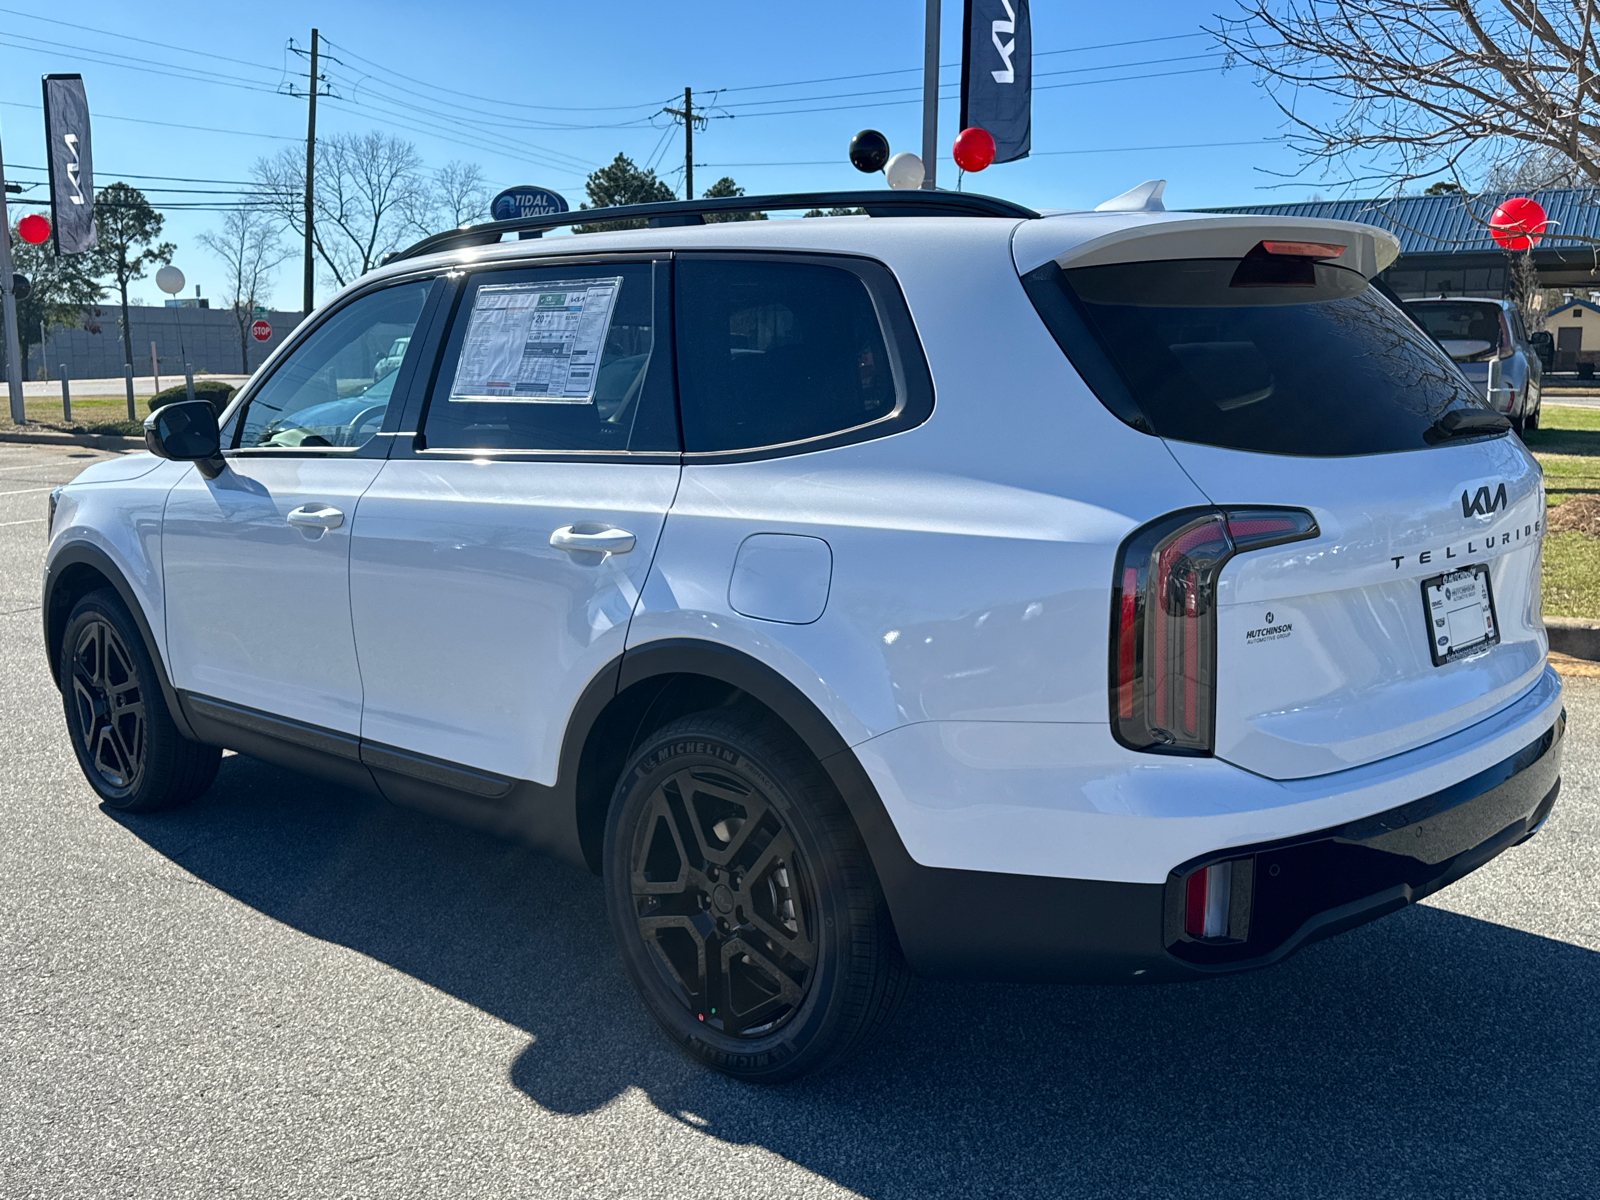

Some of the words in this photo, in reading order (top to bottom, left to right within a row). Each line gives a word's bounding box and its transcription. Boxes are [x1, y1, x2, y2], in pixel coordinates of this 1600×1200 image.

[515, 194, 548, 206] TIDAL
[521, 206, 555, 217] WAVE
[253, 326, 270, 336] STOP
[1391, 520, 1541, 570] TELLURIDE
[1246, 623, 1293, 639] HUTCHINSON
[1246, 634, 1276, 645] AUTOMOTIVE
[1276, 632, 1291, 640] GROUP
[658, 742, 735, 763] MICHELIN
[744, 762, 775, 791] PRIMACY
